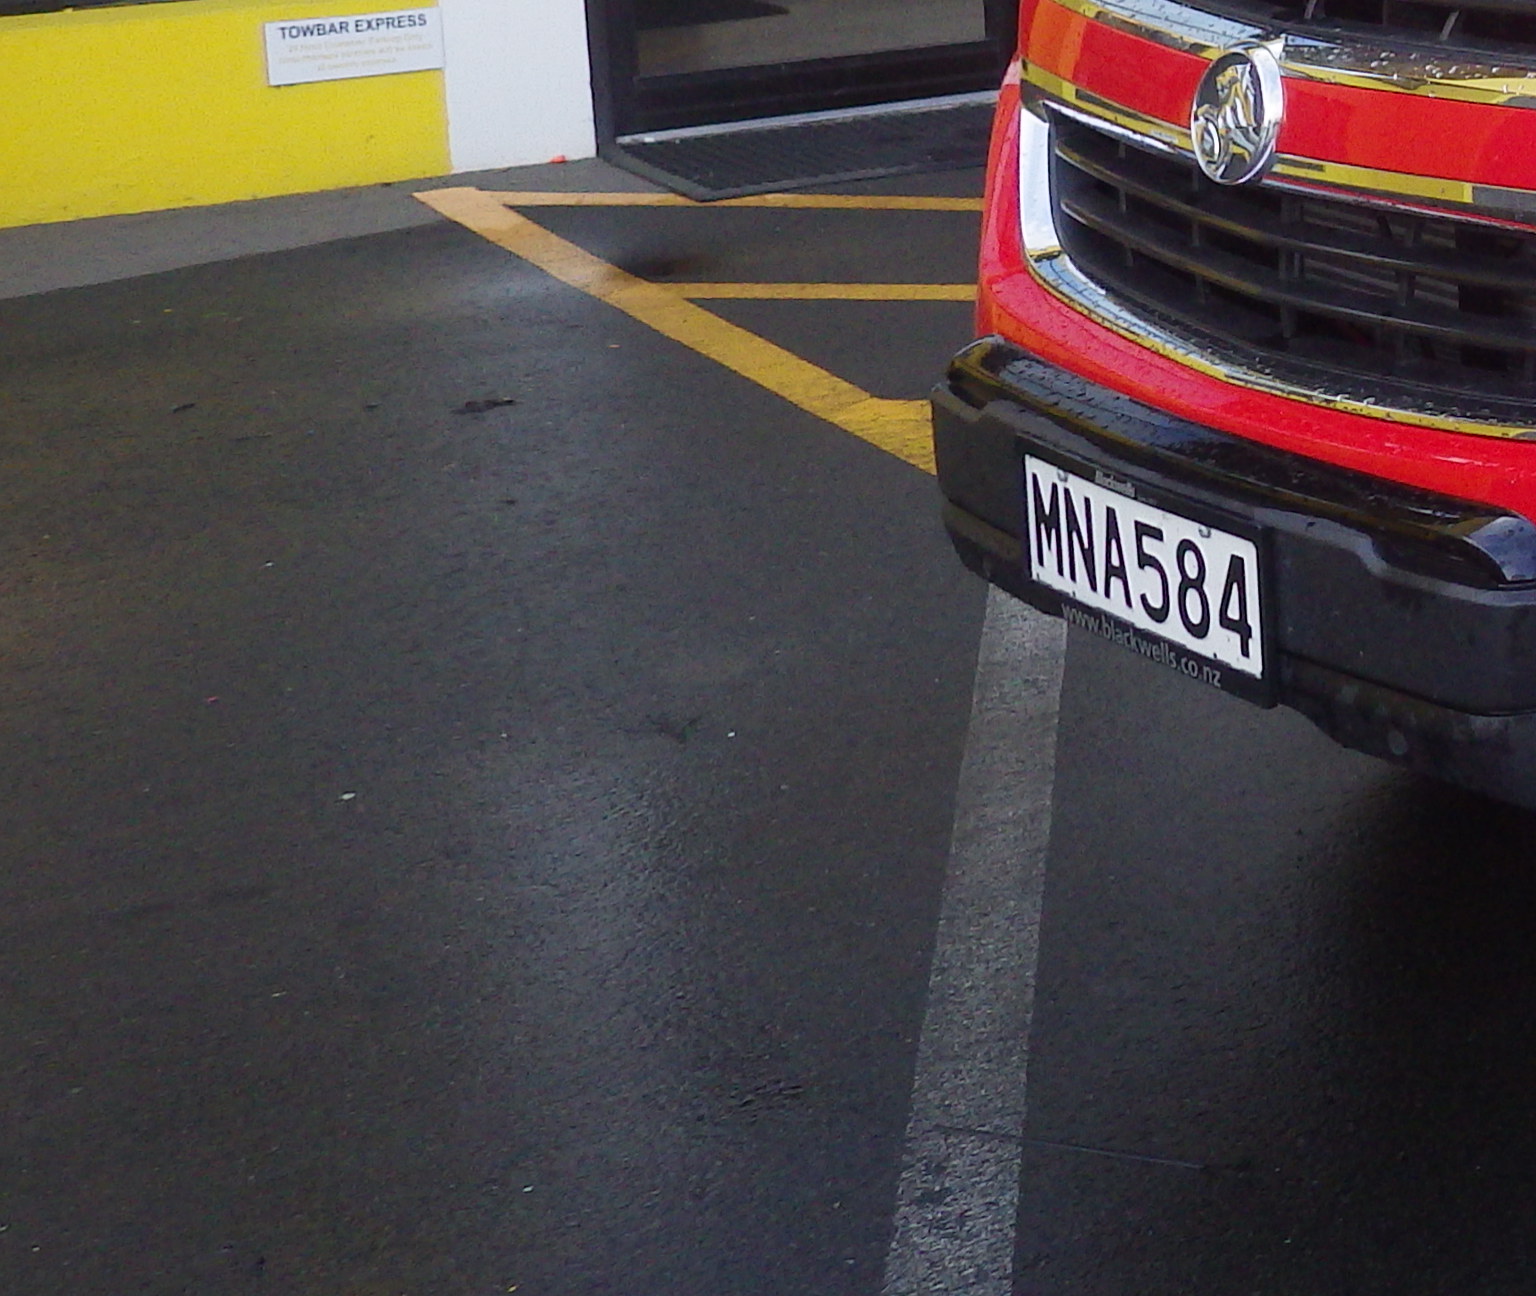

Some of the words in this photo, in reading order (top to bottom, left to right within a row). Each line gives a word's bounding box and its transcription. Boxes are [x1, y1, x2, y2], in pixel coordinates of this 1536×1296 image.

[278, 20, 350, 40] TOWBAR
[355, 13, 428, 34] EXPRESS
[1031, 471, 1252, 659] MNA584
[1061, 603, 1222, 689] www.blackwells.co.nz
